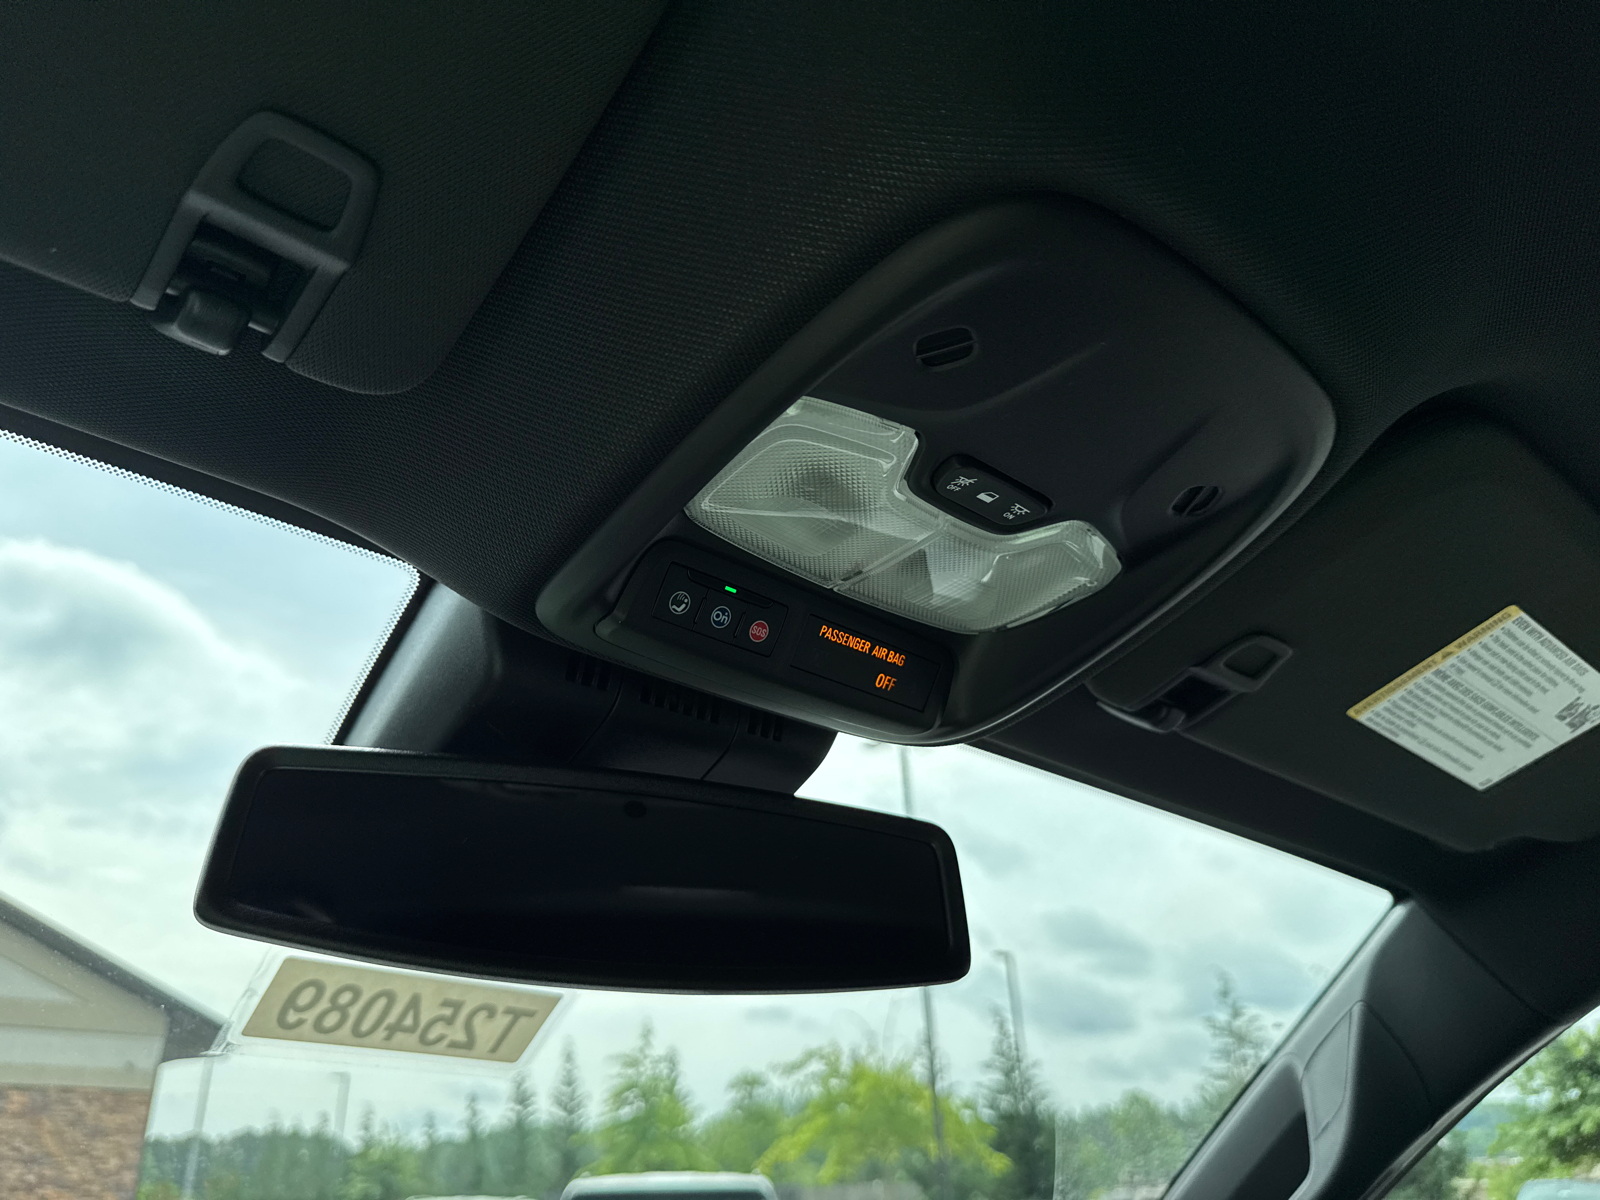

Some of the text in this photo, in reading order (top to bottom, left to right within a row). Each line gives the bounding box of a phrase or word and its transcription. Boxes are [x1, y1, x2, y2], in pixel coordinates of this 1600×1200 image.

[946, 484, 961, 492] OFF
[1002, 511, 1016, 520] ON
[751, 625, 767, 638] SOS
[819, 624, 906, 667] PASSENGER AIR BAG
[875, 672, 897, 691] OFF
